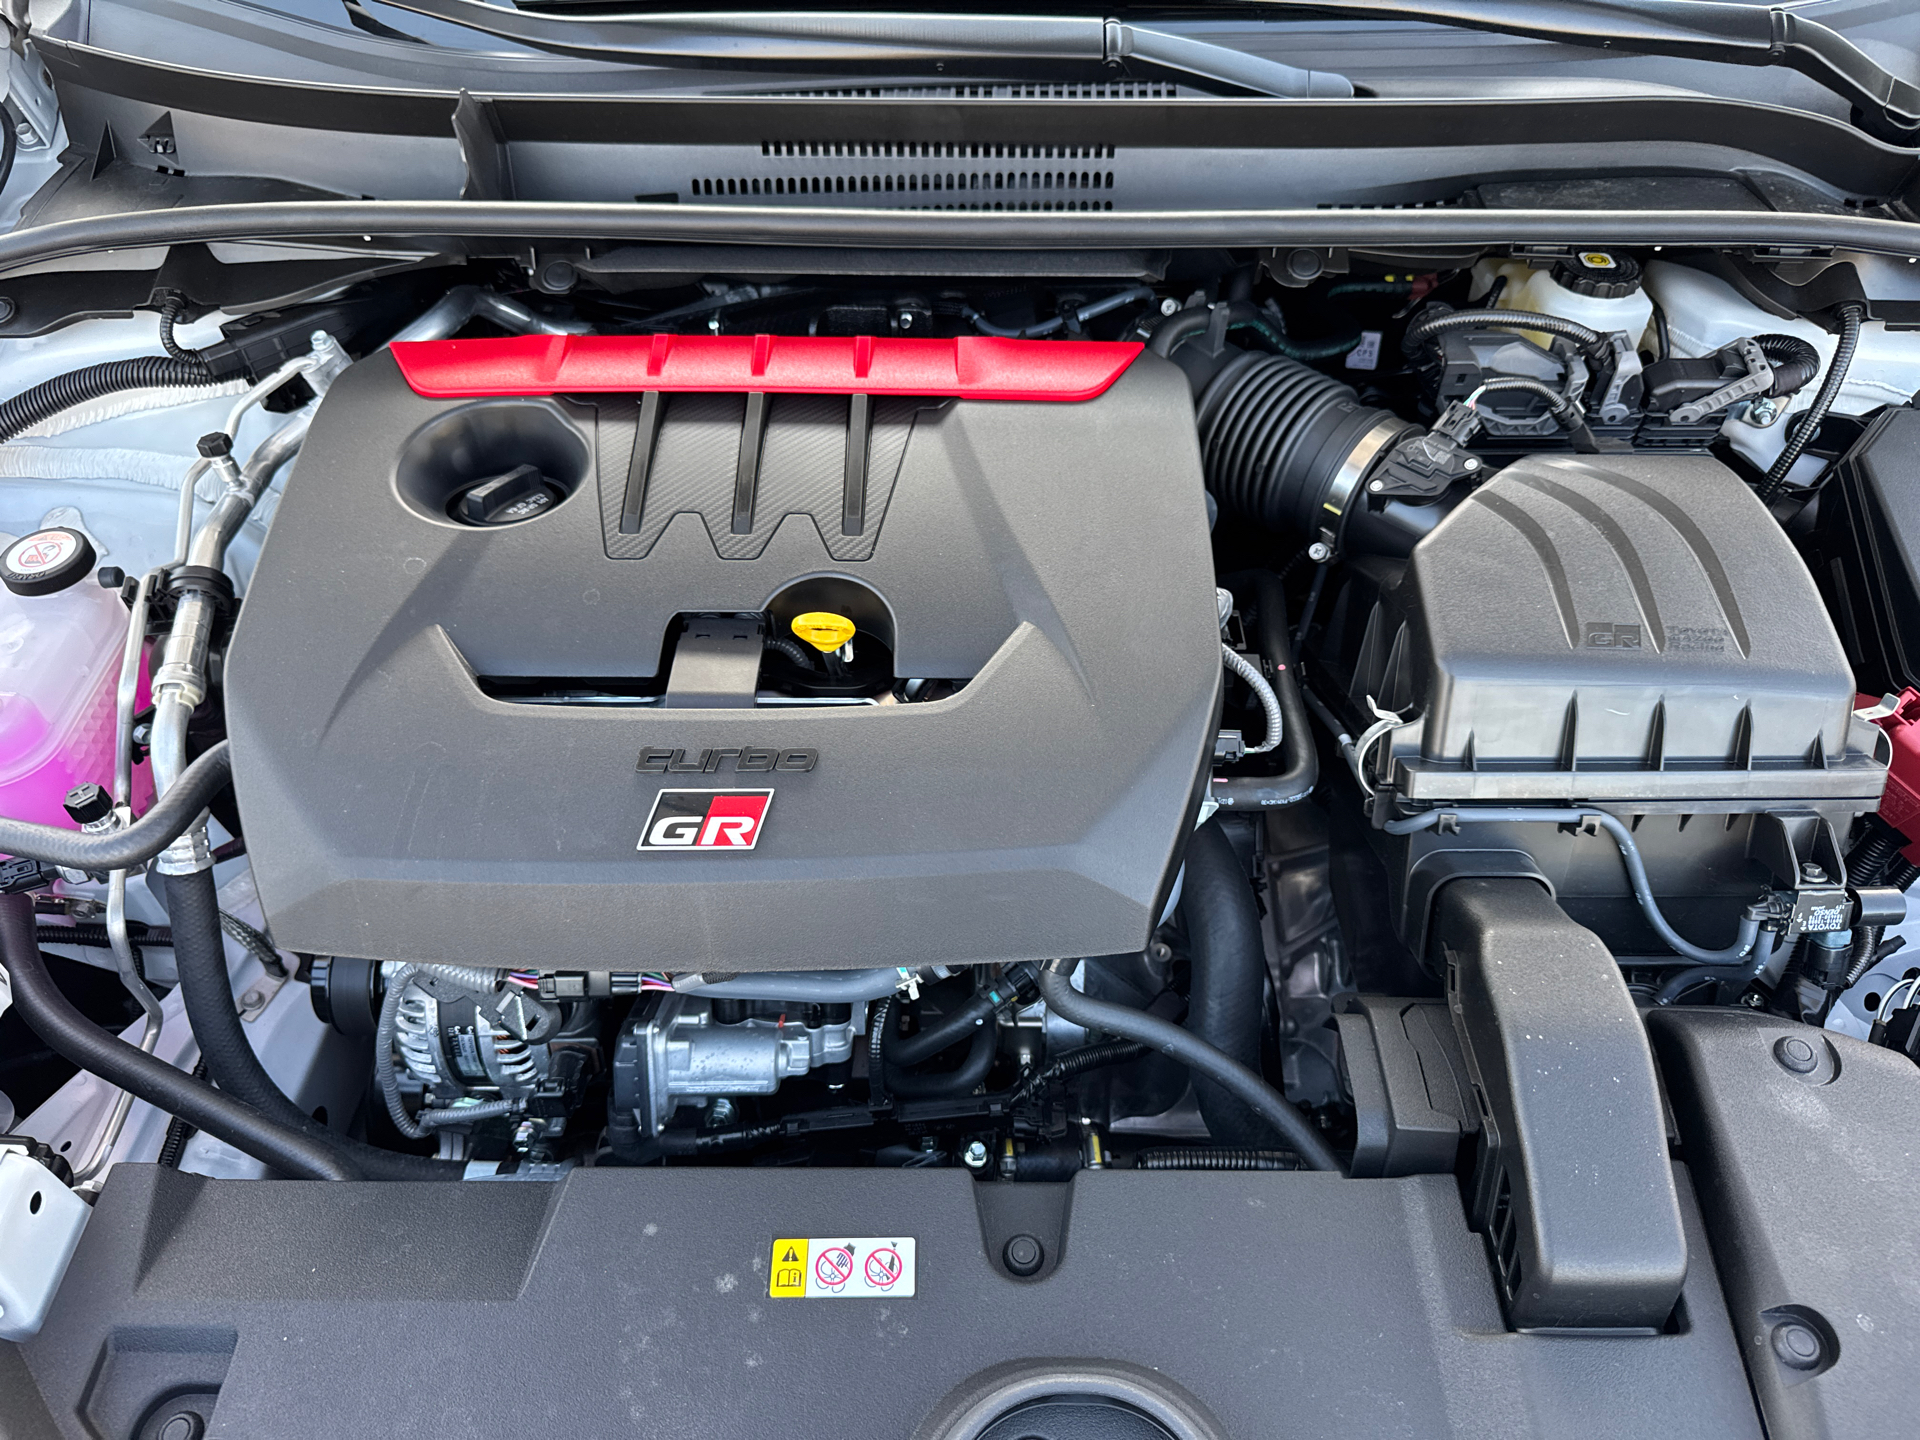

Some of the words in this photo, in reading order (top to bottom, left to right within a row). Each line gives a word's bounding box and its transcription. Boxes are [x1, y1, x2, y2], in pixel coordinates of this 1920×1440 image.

[1588, 632, 1640, 648] GR
[635, 745, 819, 773] turbo
[649, 816, 755, 845] GR
